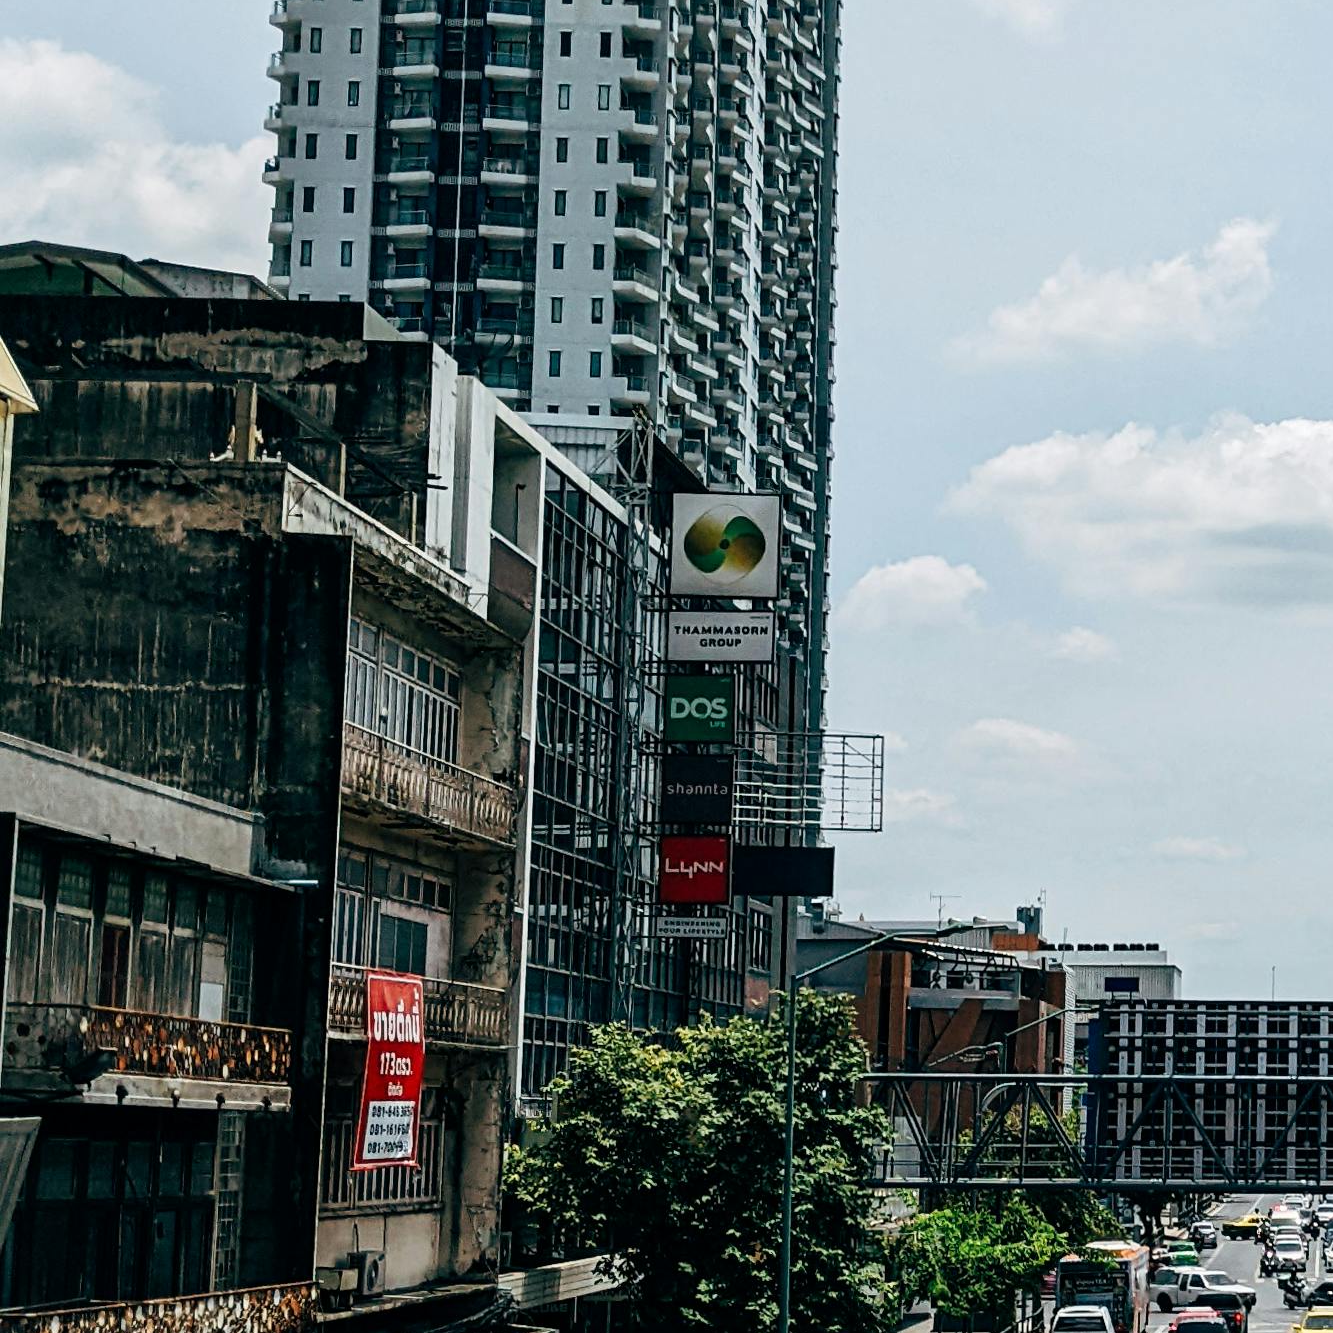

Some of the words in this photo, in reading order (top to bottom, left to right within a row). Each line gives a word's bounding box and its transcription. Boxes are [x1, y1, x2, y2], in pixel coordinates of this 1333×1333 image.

[674, 625, 769, 635] THAMMASORN
[699, 638, 742, 647] GROUP
[670, 697, 728, 719] DOS
